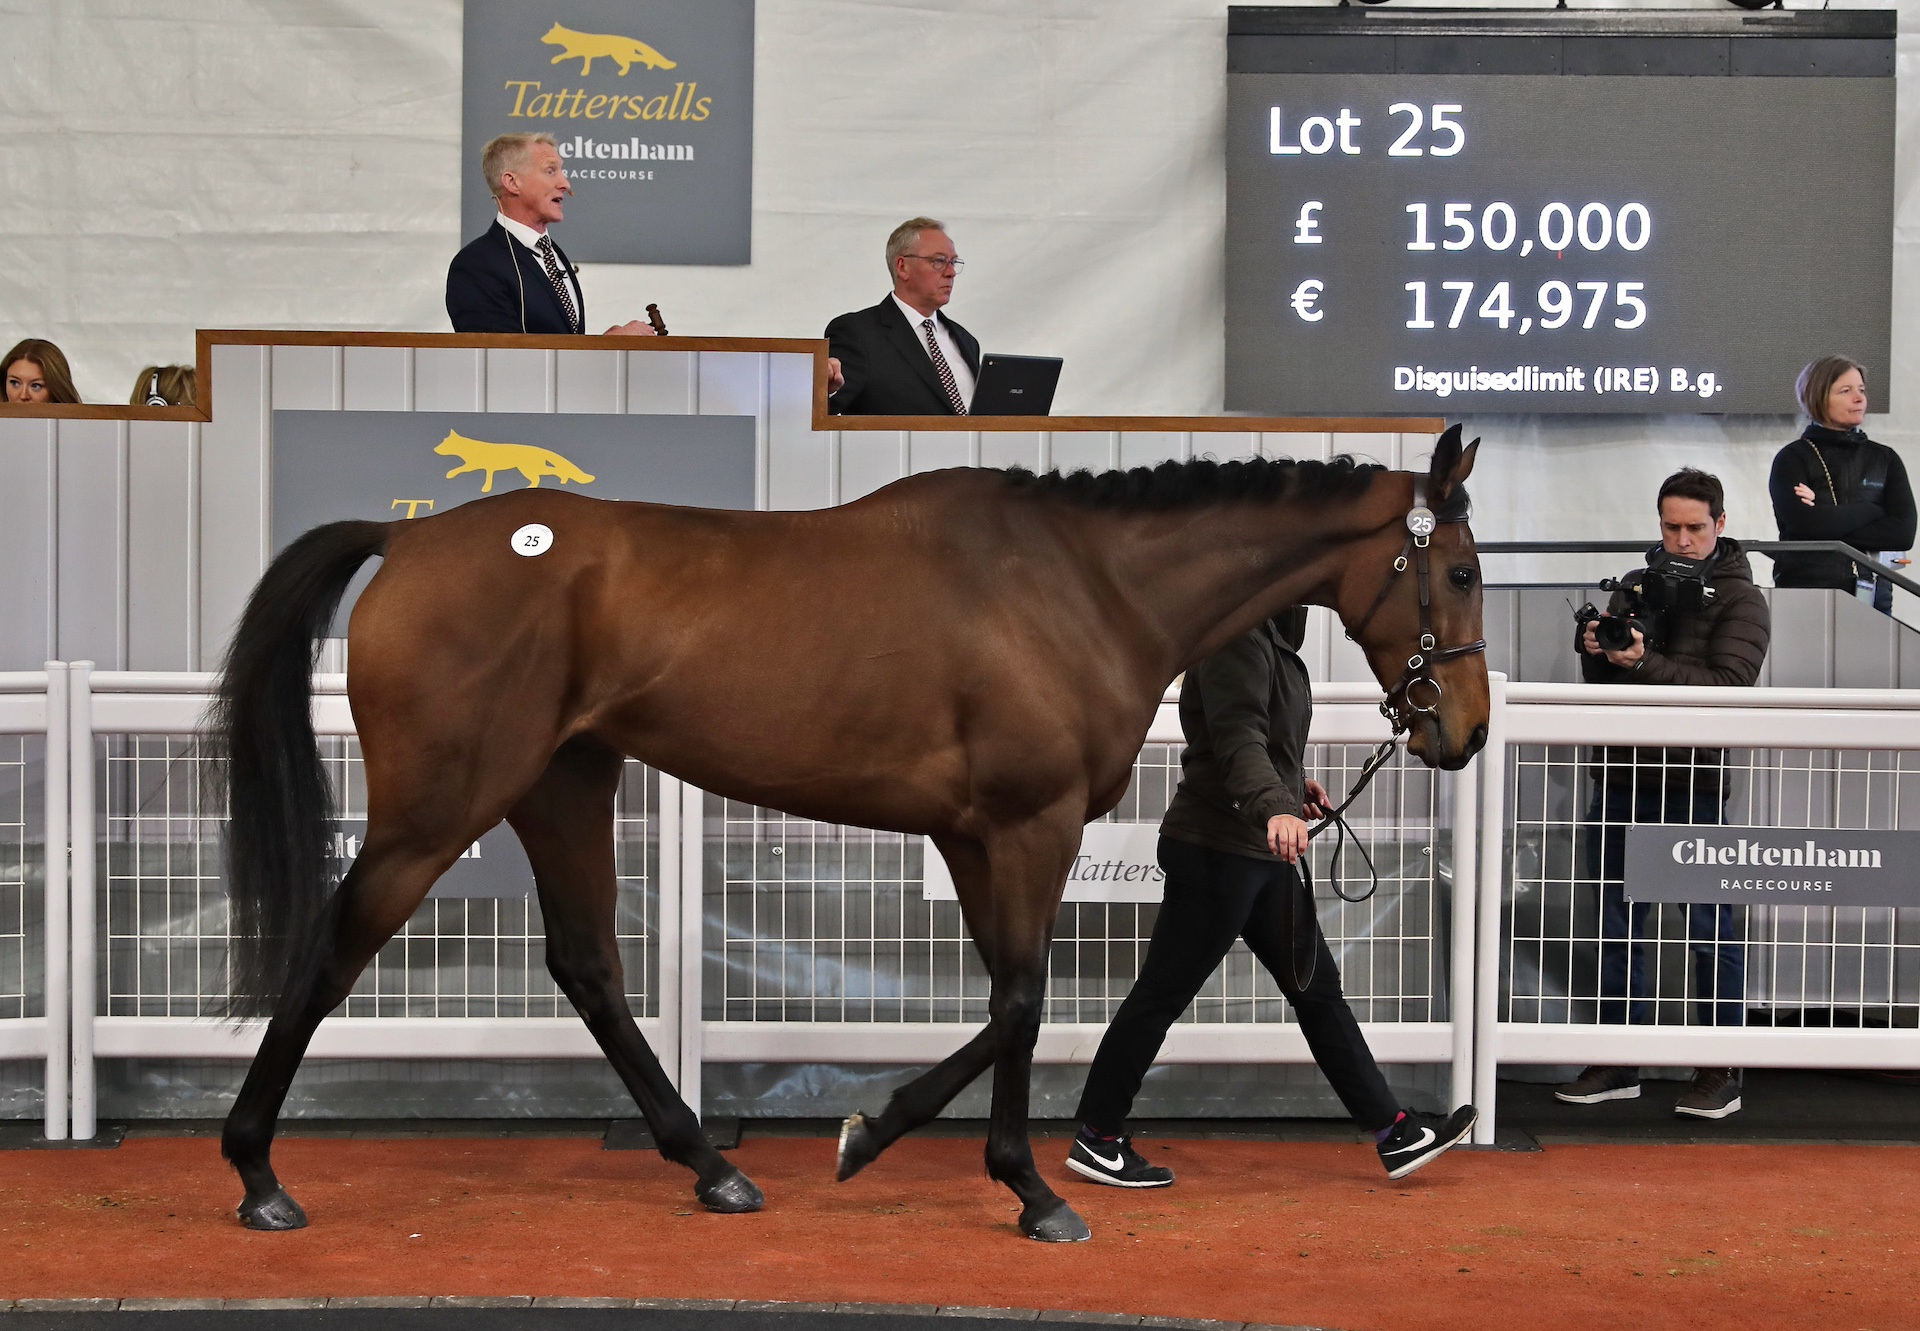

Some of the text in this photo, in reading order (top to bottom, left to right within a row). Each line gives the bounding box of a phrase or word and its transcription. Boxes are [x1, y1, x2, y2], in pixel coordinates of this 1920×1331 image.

[504, 80, 712, 122] Tattersalls
[1269, 102, 1465, 157] Lot 25
[558, 135, 695, 161] eltenham
[1293, 200, 1651, 257] £ 150,000
[1290, 279, 1647, 335] € 174,975
[1393, 365, 1723, 398] Disguisedlimit (IRE) B.g.
[1411, 516, 1432, 532] 25
[524, 535, 540, 547] 25
[1671, 838, 1882, 868] Cheltenham
[1067, 855, 1166, 882] Tatters
[1720, 878, 1833, 892] RACECOURSE
